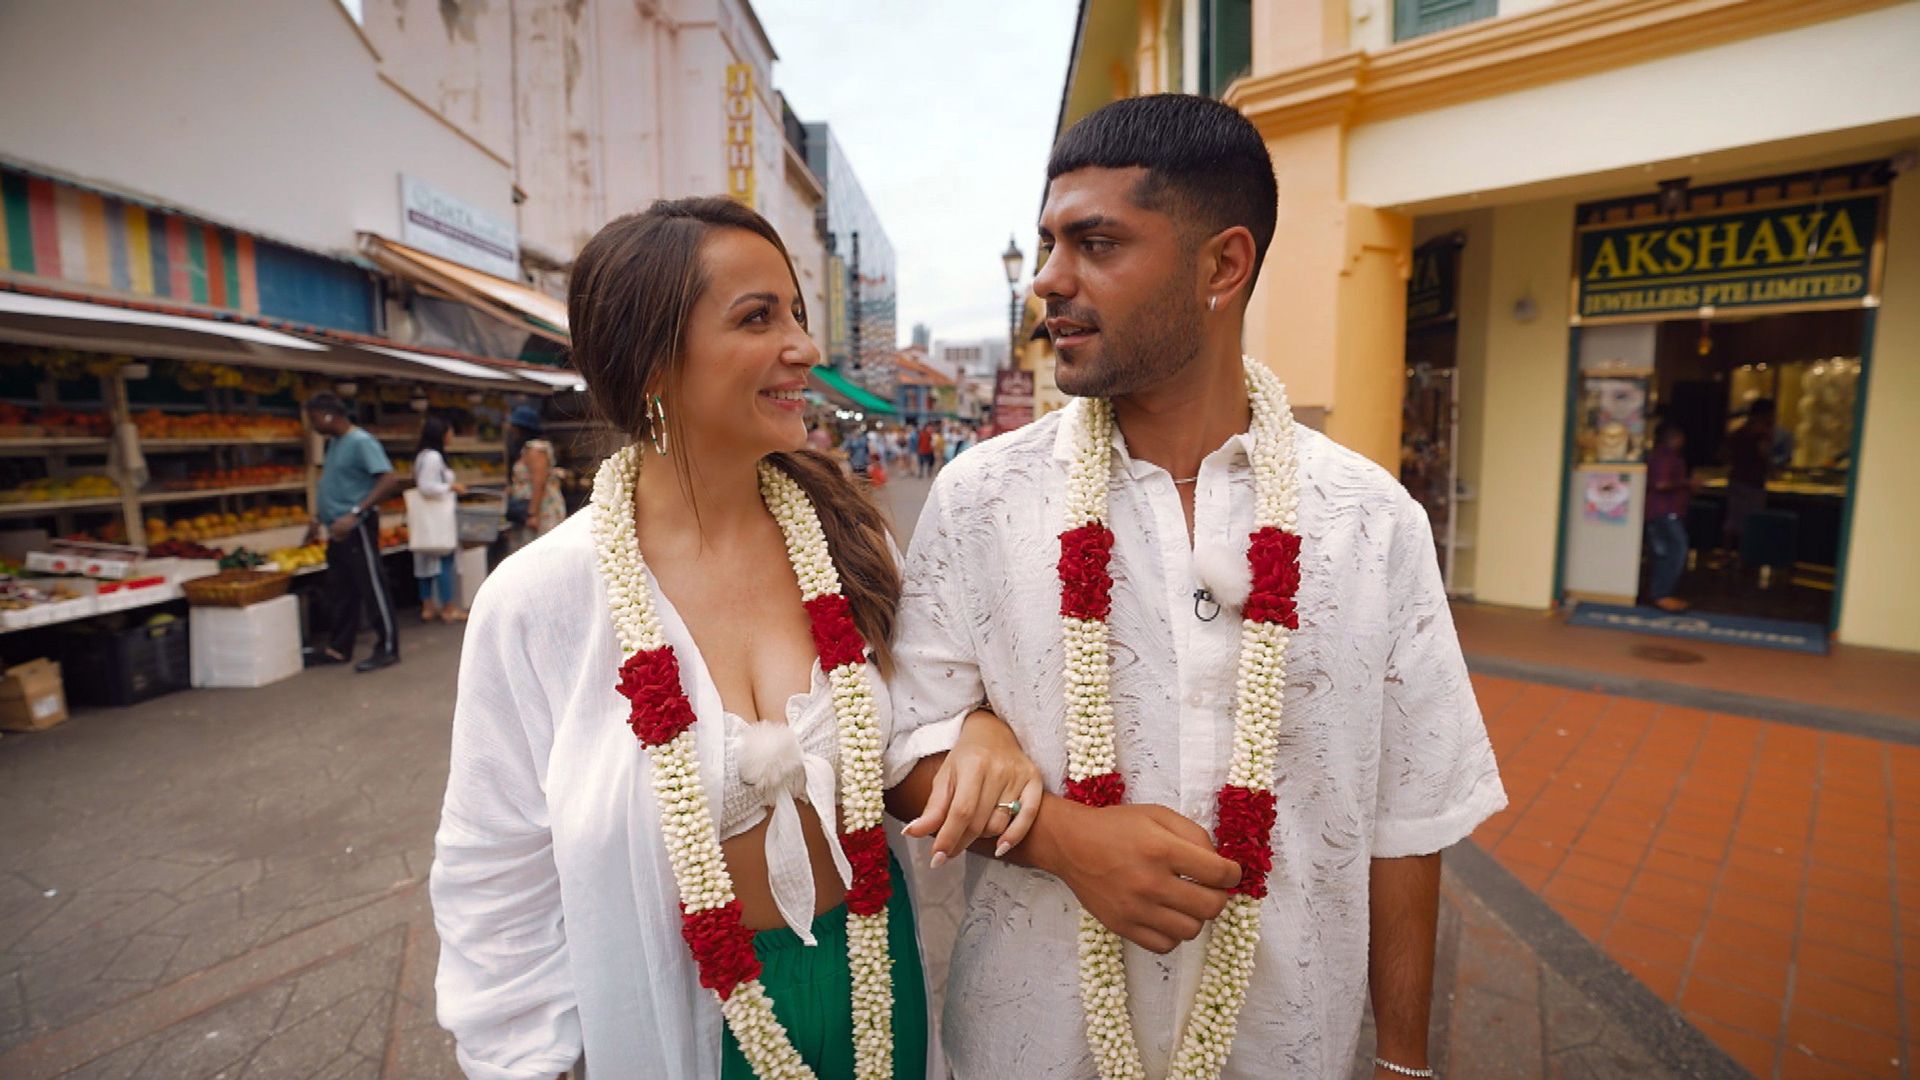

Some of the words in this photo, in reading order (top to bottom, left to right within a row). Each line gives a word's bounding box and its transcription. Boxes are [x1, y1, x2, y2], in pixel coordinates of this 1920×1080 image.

[1587, 208, 1864, 280] AKSHAYA
[1583, 286, 1699, 314] JEWELLERS
[1703, 281, 1748, 304] PTE
[1752, 273, 1864, 299] LIMITED
